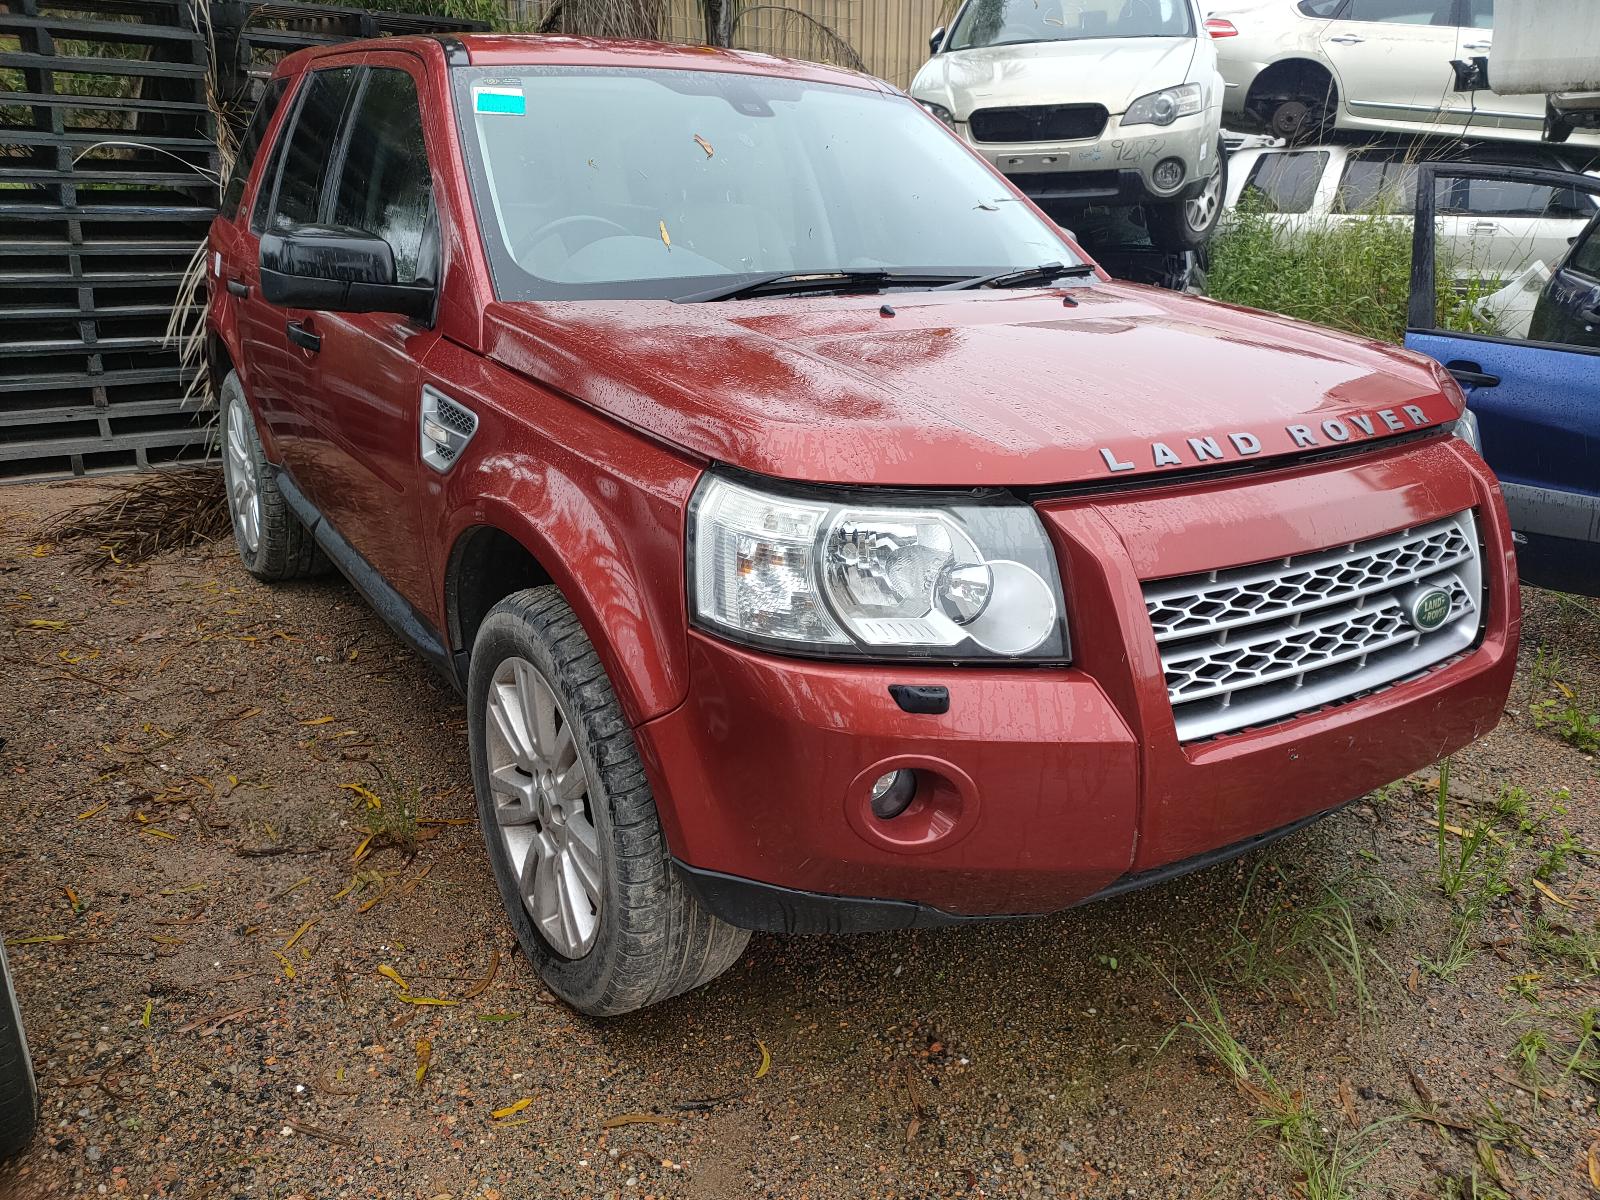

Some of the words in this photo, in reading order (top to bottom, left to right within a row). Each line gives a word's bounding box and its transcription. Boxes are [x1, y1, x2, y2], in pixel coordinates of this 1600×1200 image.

[1099, 432, 1262, 473] LAND
[1284, 404, 1430, 447] ROVER
[1424, 597, 1442, 612] LAND
